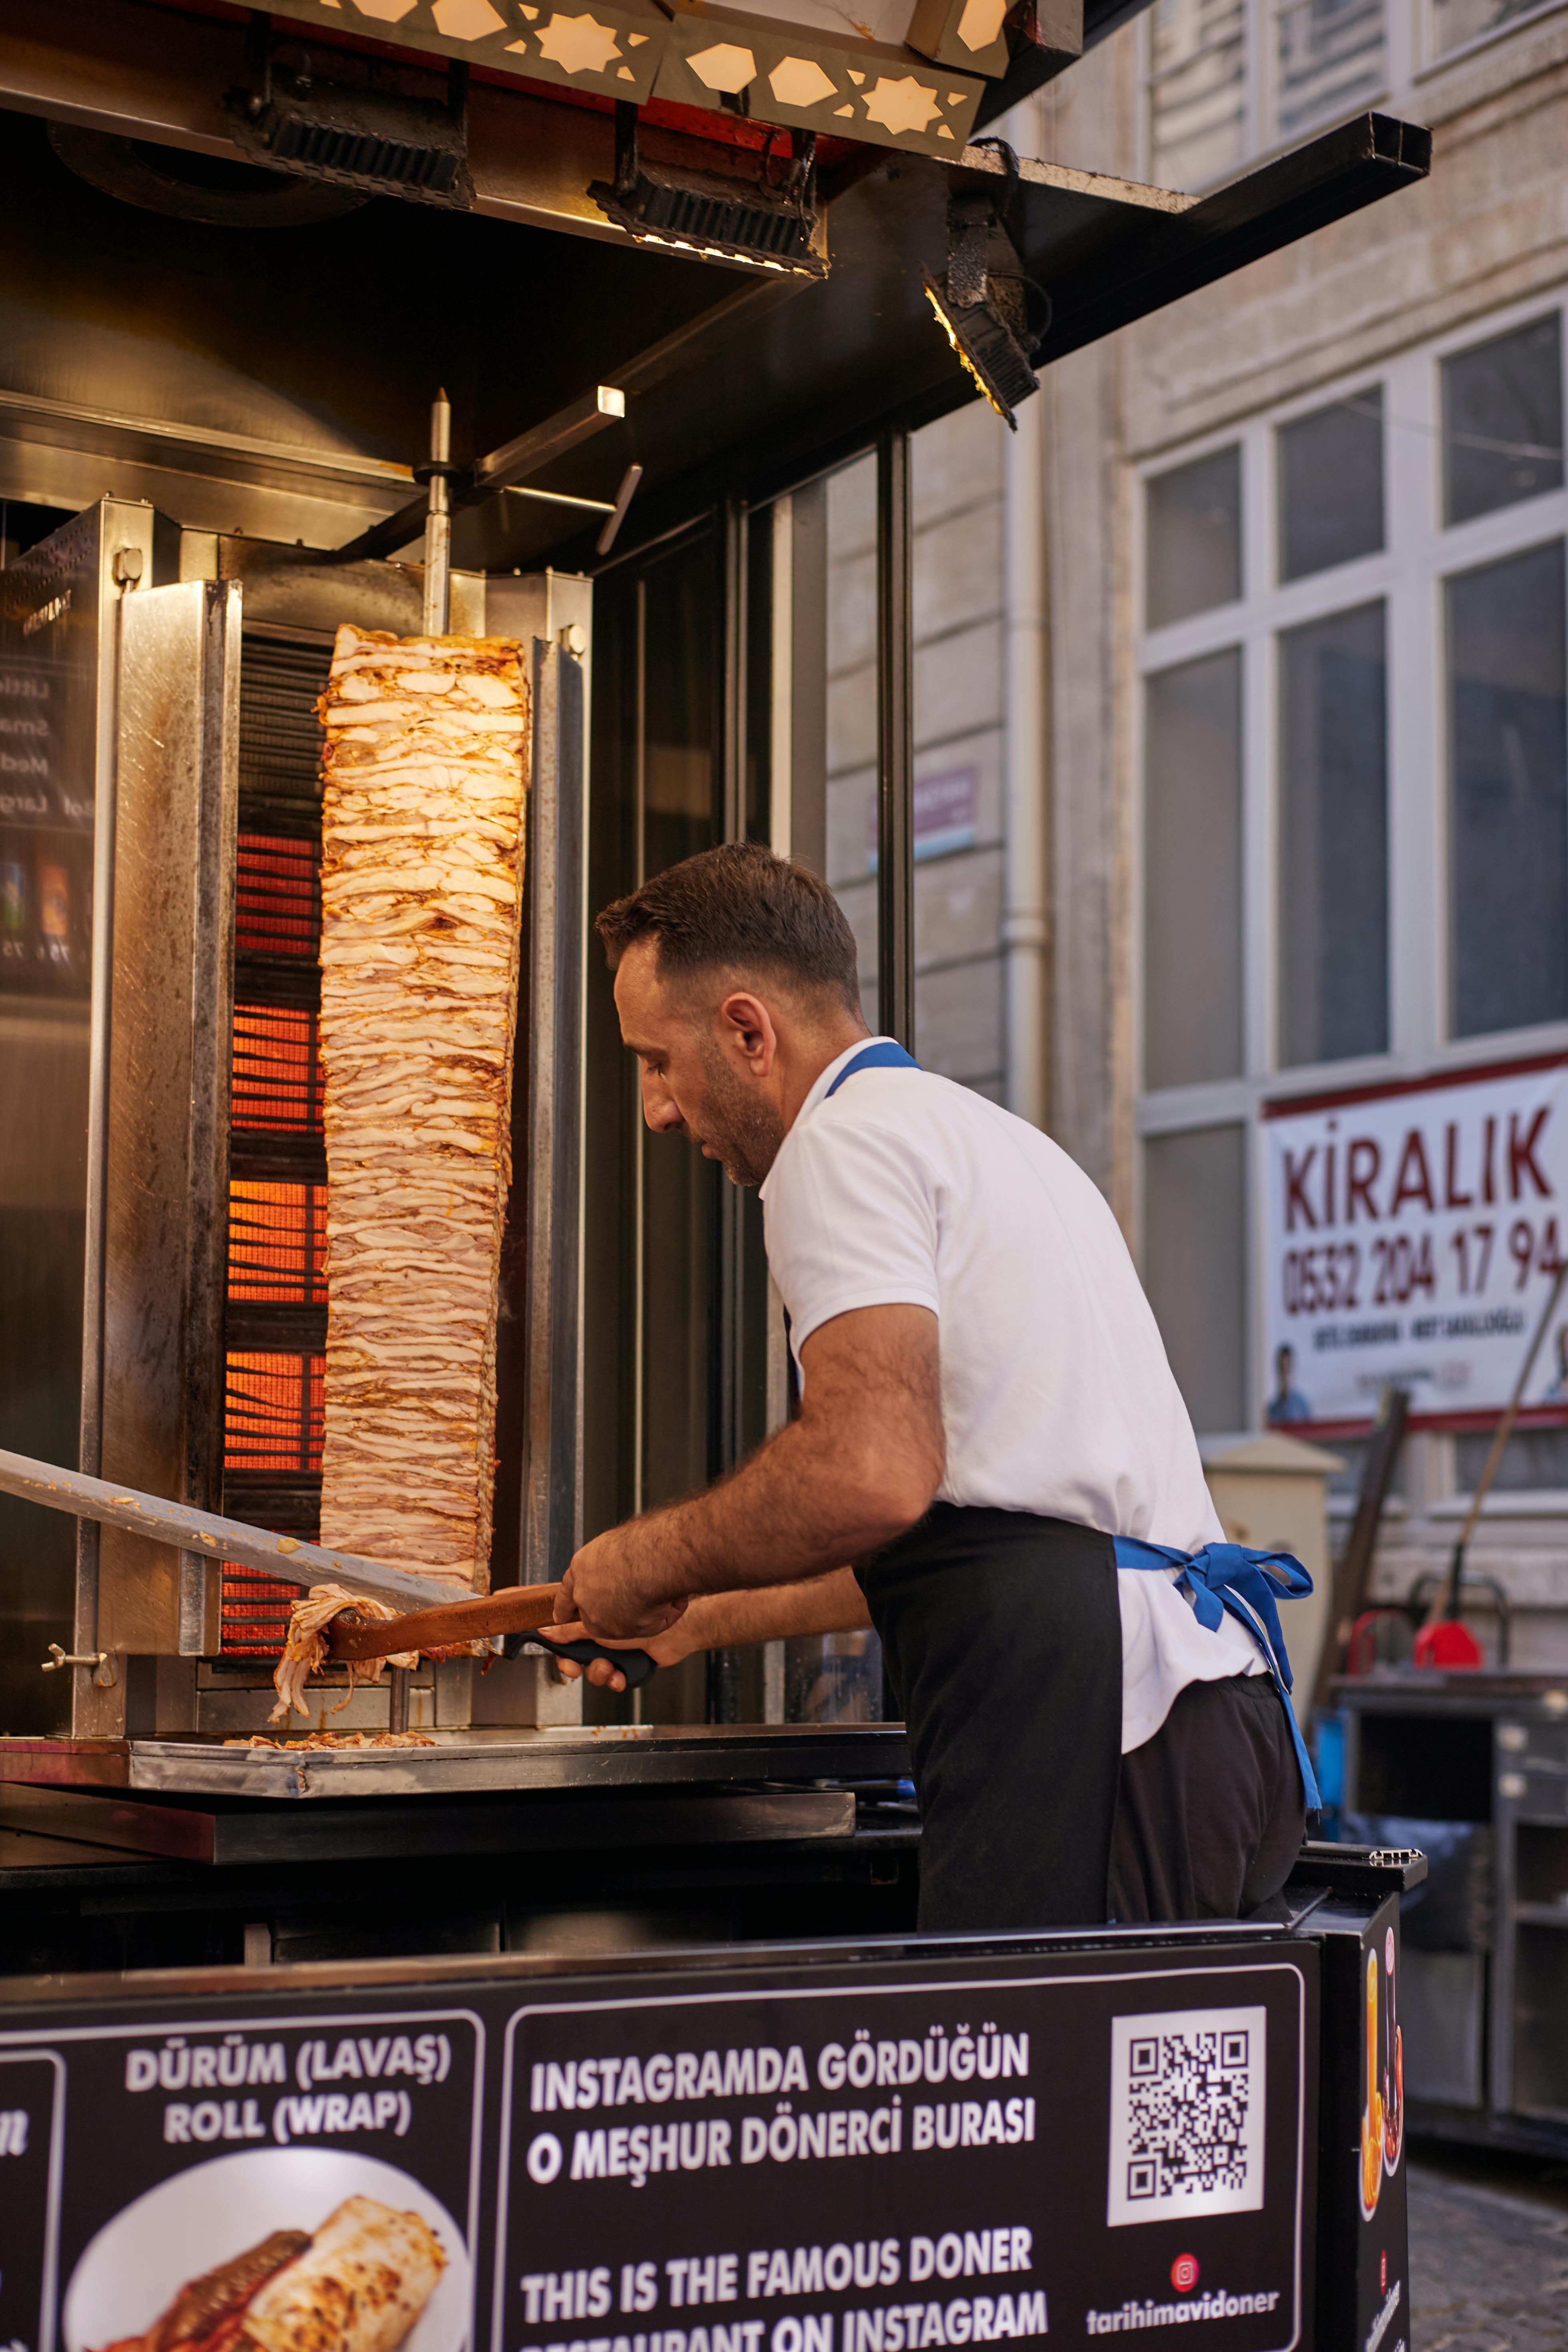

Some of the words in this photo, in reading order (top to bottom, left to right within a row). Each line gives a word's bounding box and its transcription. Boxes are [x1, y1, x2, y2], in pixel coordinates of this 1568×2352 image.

[1283, 1105, 1552, 1233] KİRALIK
[1370, 1232, 1436, 1304] 204
[1452, 1223, 1494, 1295] 17
[1509, 1216, 1563, 1292] 94
[125, 2035, 286, 2091] DÜRÜM
[296, 2034, 451, 2091] (LAVAŞ)
[530, 2045, 809, 2112] INSTAGRAMDA
[818, 2021, 1029, 2090] GÖRDÜĞÜN
[164, 2099, 265, 2143] ROLL
[273, 2091, 411, 2144] (WRAP)
[527, 2133, 562, 2184] O
[570, 2119, 731, 2187] MEŞHUR
[740, 2094, 902, 2164] DÖNERCİ
[913, 2097, 1035, 2150] BURASI
[520, 2266, 611, 2324] THIS
[621, 2262, 657, 2312] IS
[666, 2254, 738, 2307] THE
[747, 2238, 901, 2298] FAMOUS
[910, 2226, 1032, 2282] DONER
[1086, 2289, 1280, 2335] tarihimavidoner
[771, 2313, 833, 2352] ON
[843, 2290, 1048, 2352] INSTAGRAM
